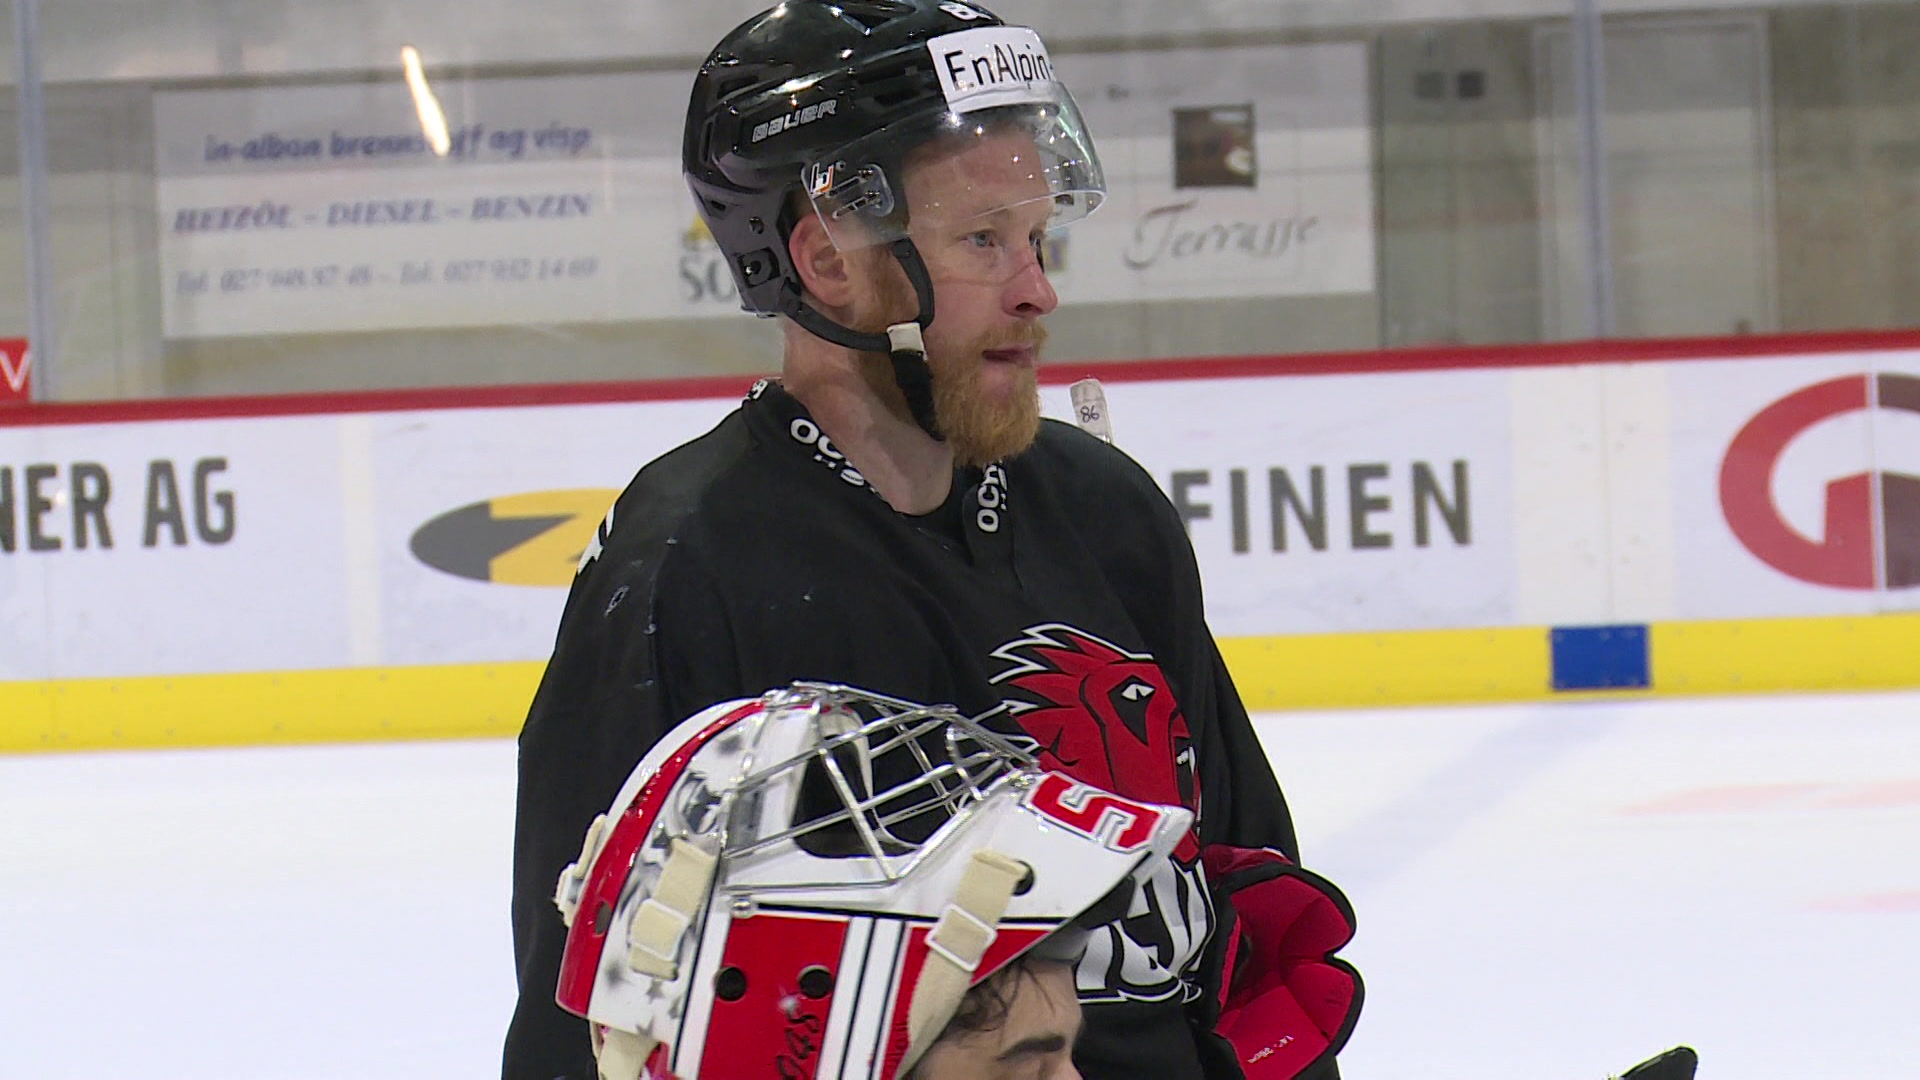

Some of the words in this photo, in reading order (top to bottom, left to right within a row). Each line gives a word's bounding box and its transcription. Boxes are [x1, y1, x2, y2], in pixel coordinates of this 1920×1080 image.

[329, 123, 483, 159] brennsoff
[326, 202, 438, 226] DIESEL
[471, 193, 592, 221] BENZIN
[1080, 405, 1100, 423] 86
[143, 457, 236, 547] AG
